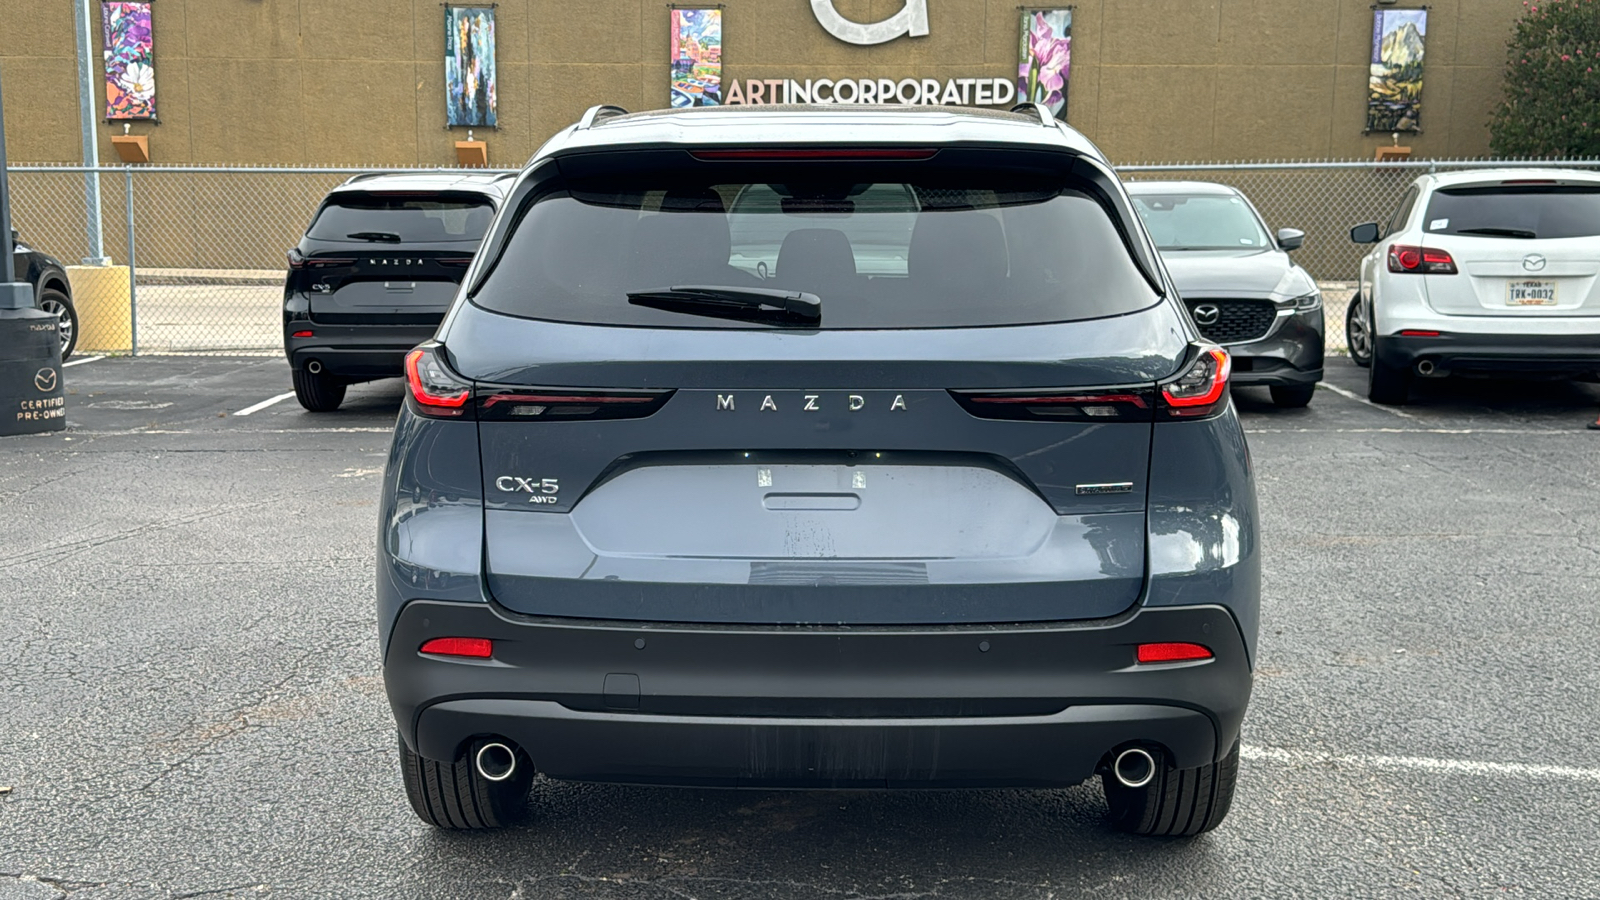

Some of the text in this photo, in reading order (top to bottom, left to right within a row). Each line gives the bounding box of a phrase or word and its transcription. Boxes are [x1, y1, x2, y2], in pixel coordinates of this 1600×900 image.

[369, 258, 425, 266] MAZDA
[716, 394, 908, 412] MAZDA
[495, 475, 560, 494] CX-5
[528, 494, 558, 504] AWD
